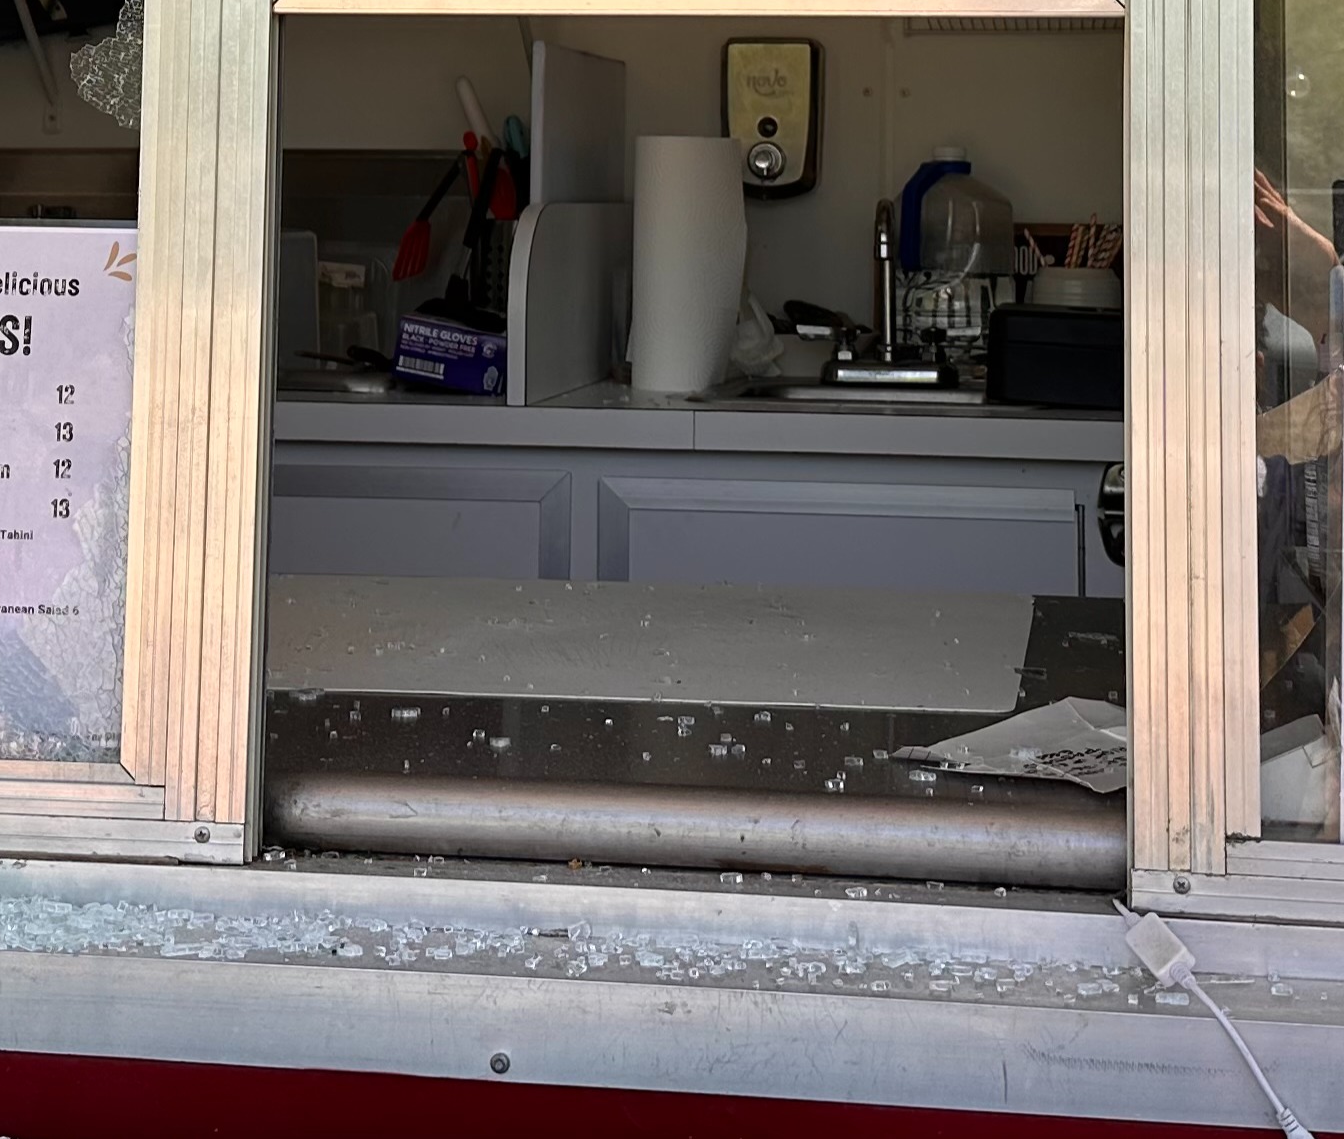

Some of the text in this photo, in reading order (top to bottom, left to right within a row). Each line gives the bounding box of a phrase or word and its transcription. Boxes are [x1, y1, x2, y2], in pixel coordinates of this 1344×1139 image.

[402, 332, 425, 343] BLACK
[428, 338, 459, 350] POWDER
[459, 344, 476, 354] FREE
[403, 323, 478, 346] NITRILE GLOVES
[56, 385, 76, 405] 12
[54, 422, 75, 443] 13
[53, 460, 72, 480] 12
[51, 499, 71, 519] 13
[0, 529, 34, 541] Tahini
